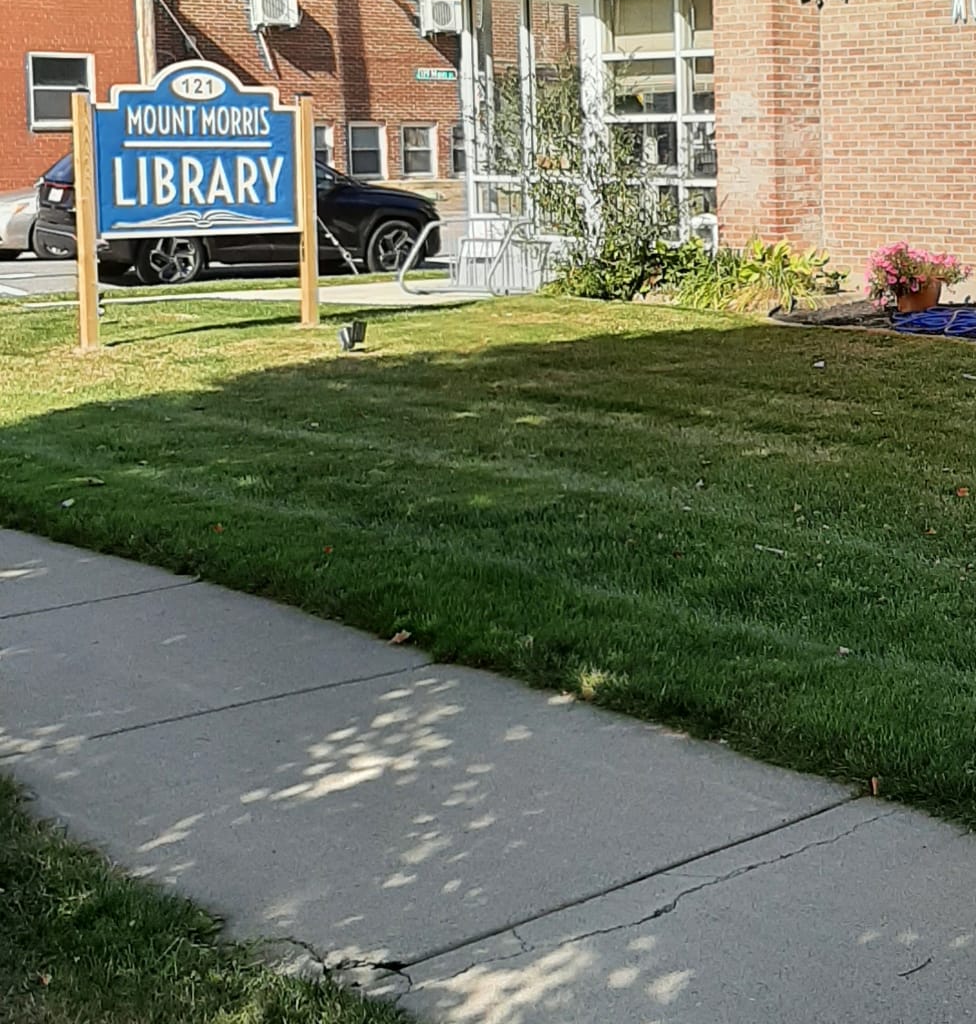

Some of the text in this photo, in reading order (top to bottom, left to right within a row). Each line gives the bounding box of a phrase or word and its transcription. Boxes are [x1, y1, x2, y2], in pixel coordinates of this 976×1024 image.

[181, 80, 213, 94] 121
[127, 105, 270, 135] MOUNT MORRIS
[113, 156, 284, 206] LIBRARY
